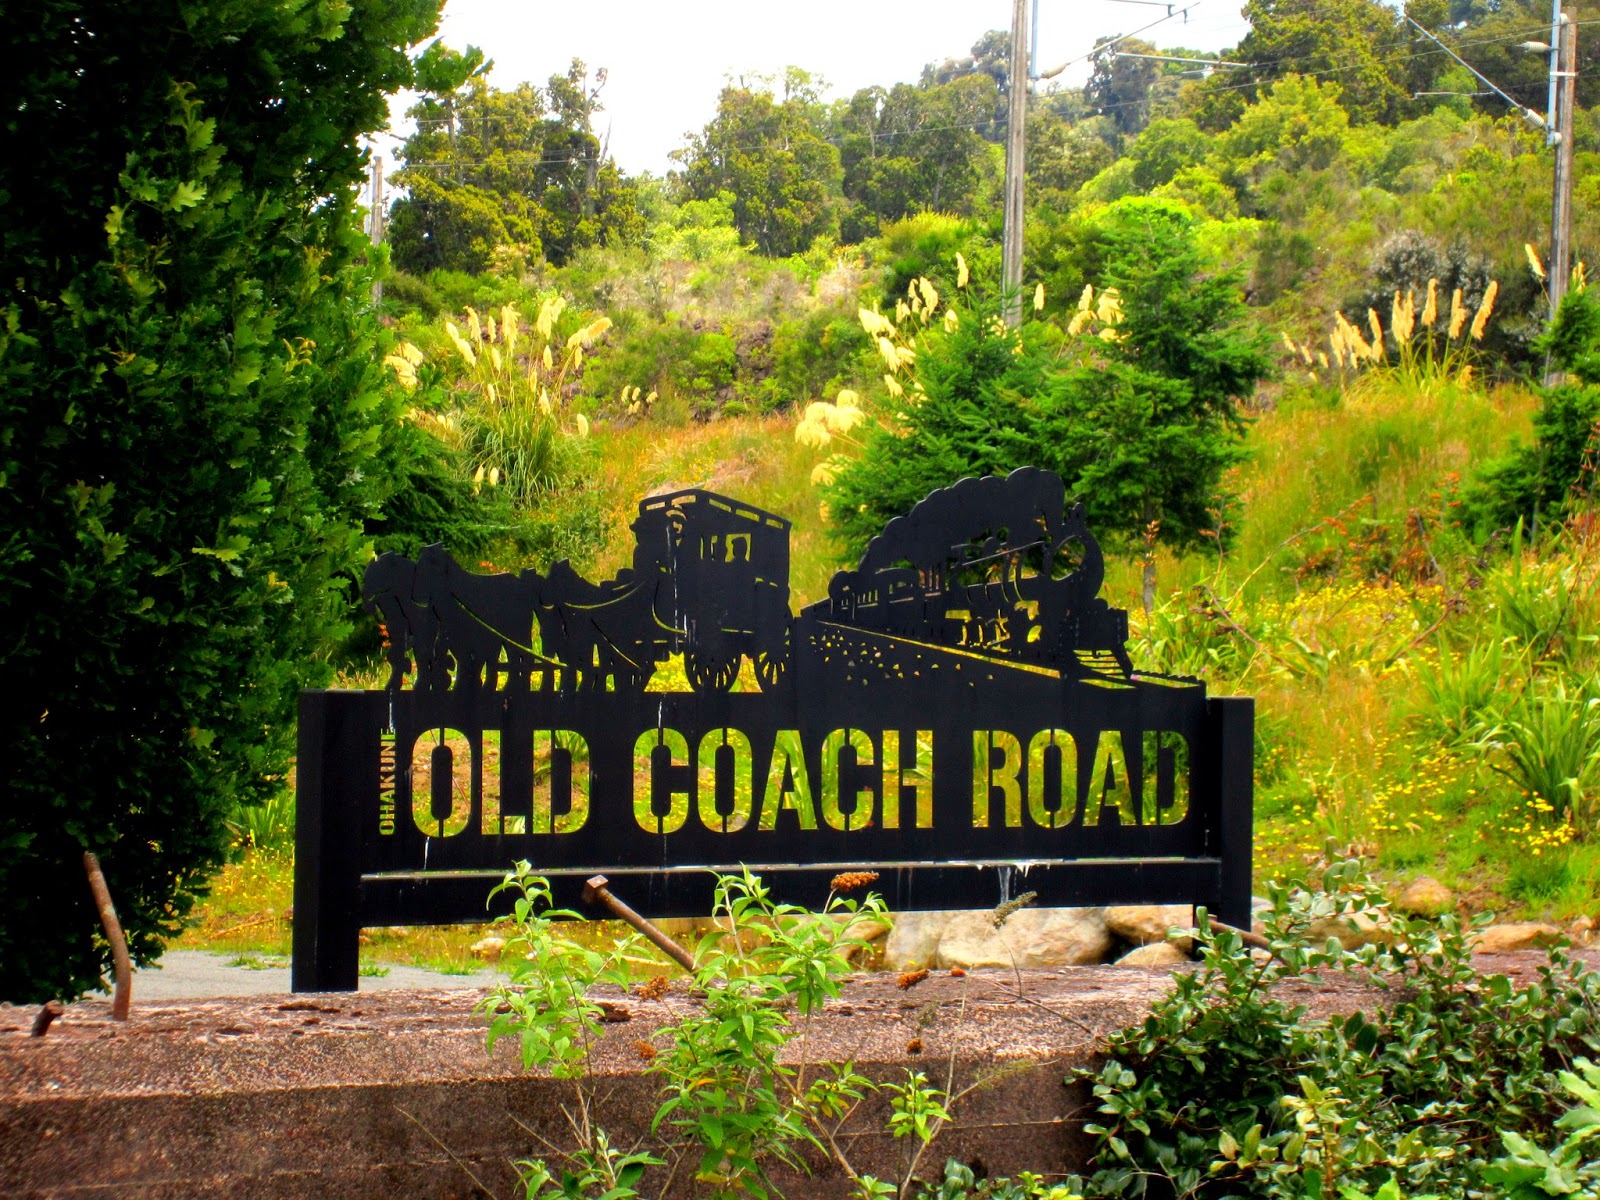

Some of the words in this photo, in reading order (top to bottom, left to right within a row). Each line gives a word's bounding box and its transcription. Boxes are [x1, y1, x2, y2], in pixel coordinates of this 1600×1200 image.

[379, 728, 396, 836] OHAKUNE
[411, 728, 590, 837] OLD
[633, 728, 934, 834] COACH
[973, 728, 1190, 829] ROAD
